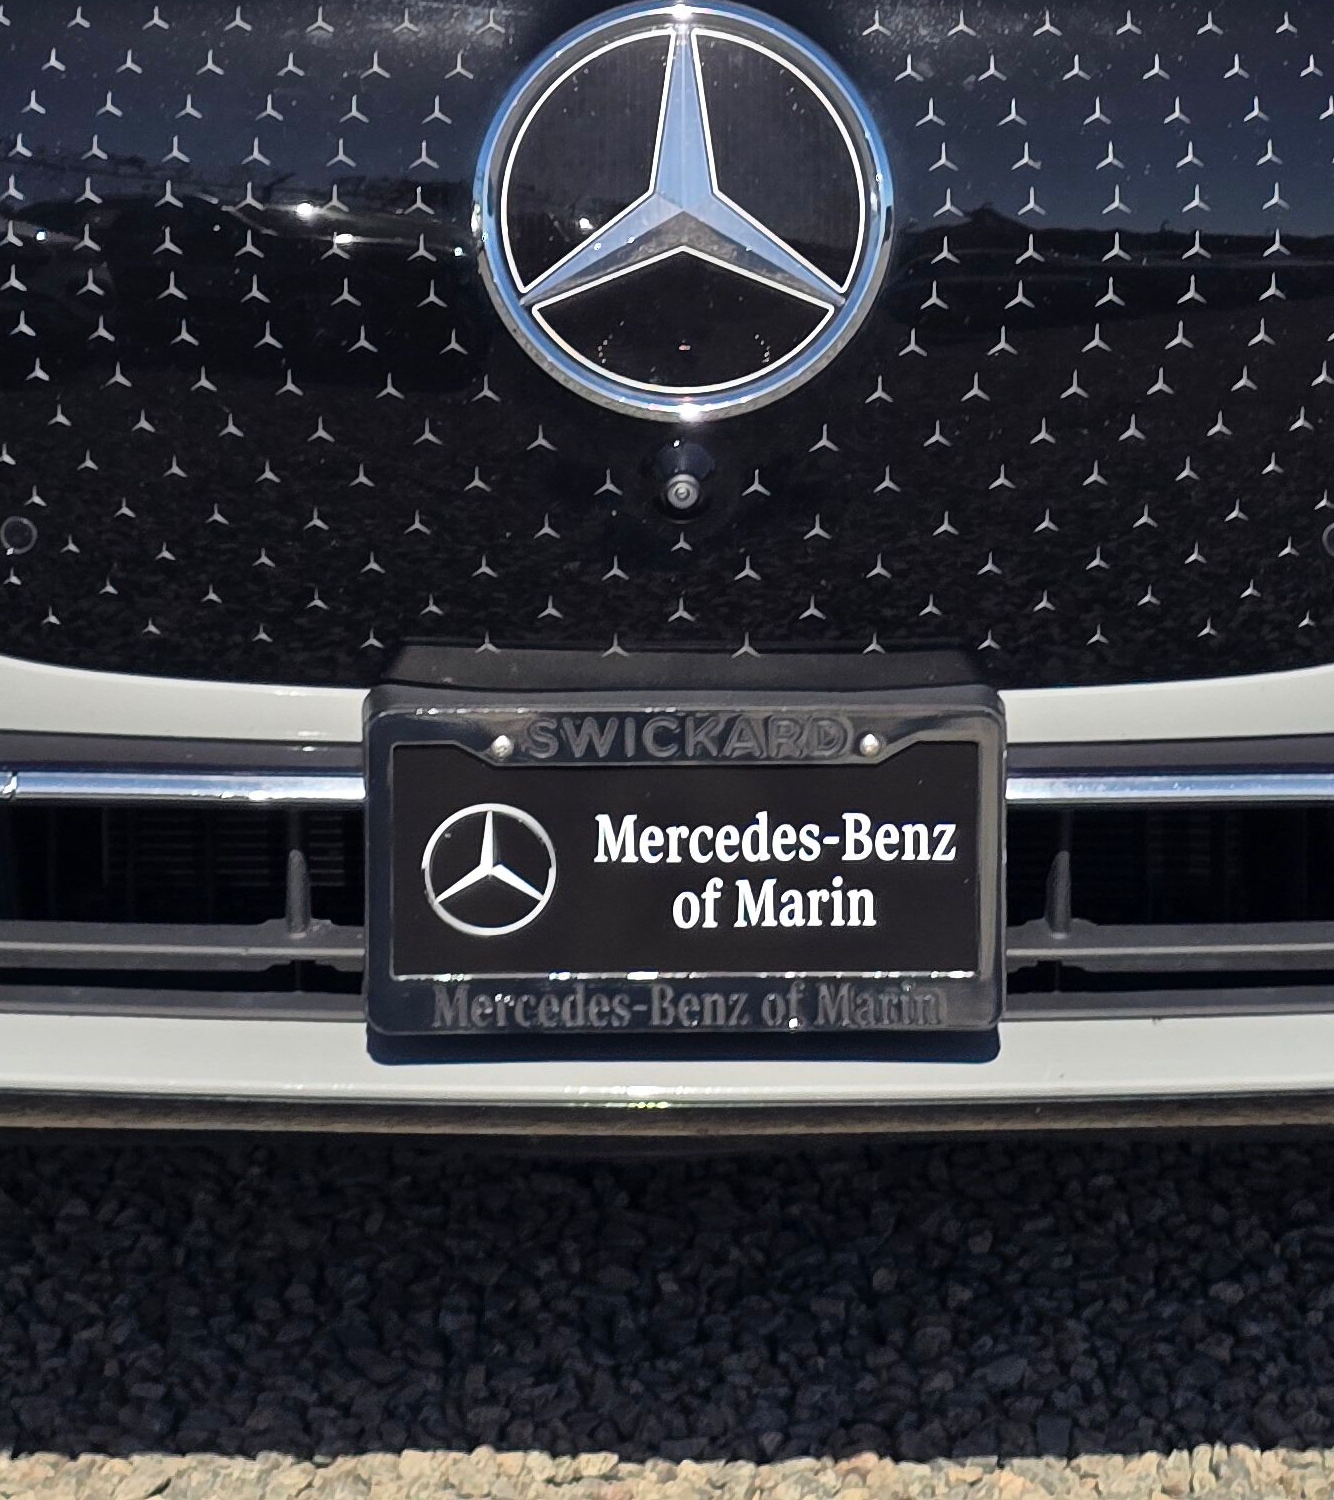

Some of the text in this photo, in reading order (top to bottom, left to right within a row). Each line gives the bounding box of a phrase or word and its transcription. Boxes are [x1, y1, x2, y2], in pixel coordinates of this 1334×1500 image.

[525, 715, 851, 759] SWICKARD
[593, 811, 957, 864] Mercedes-Benz
[672, 876, 877, 930] of Marin
[431, 981, 945, 1029] Mercedes-Benz of Marin
